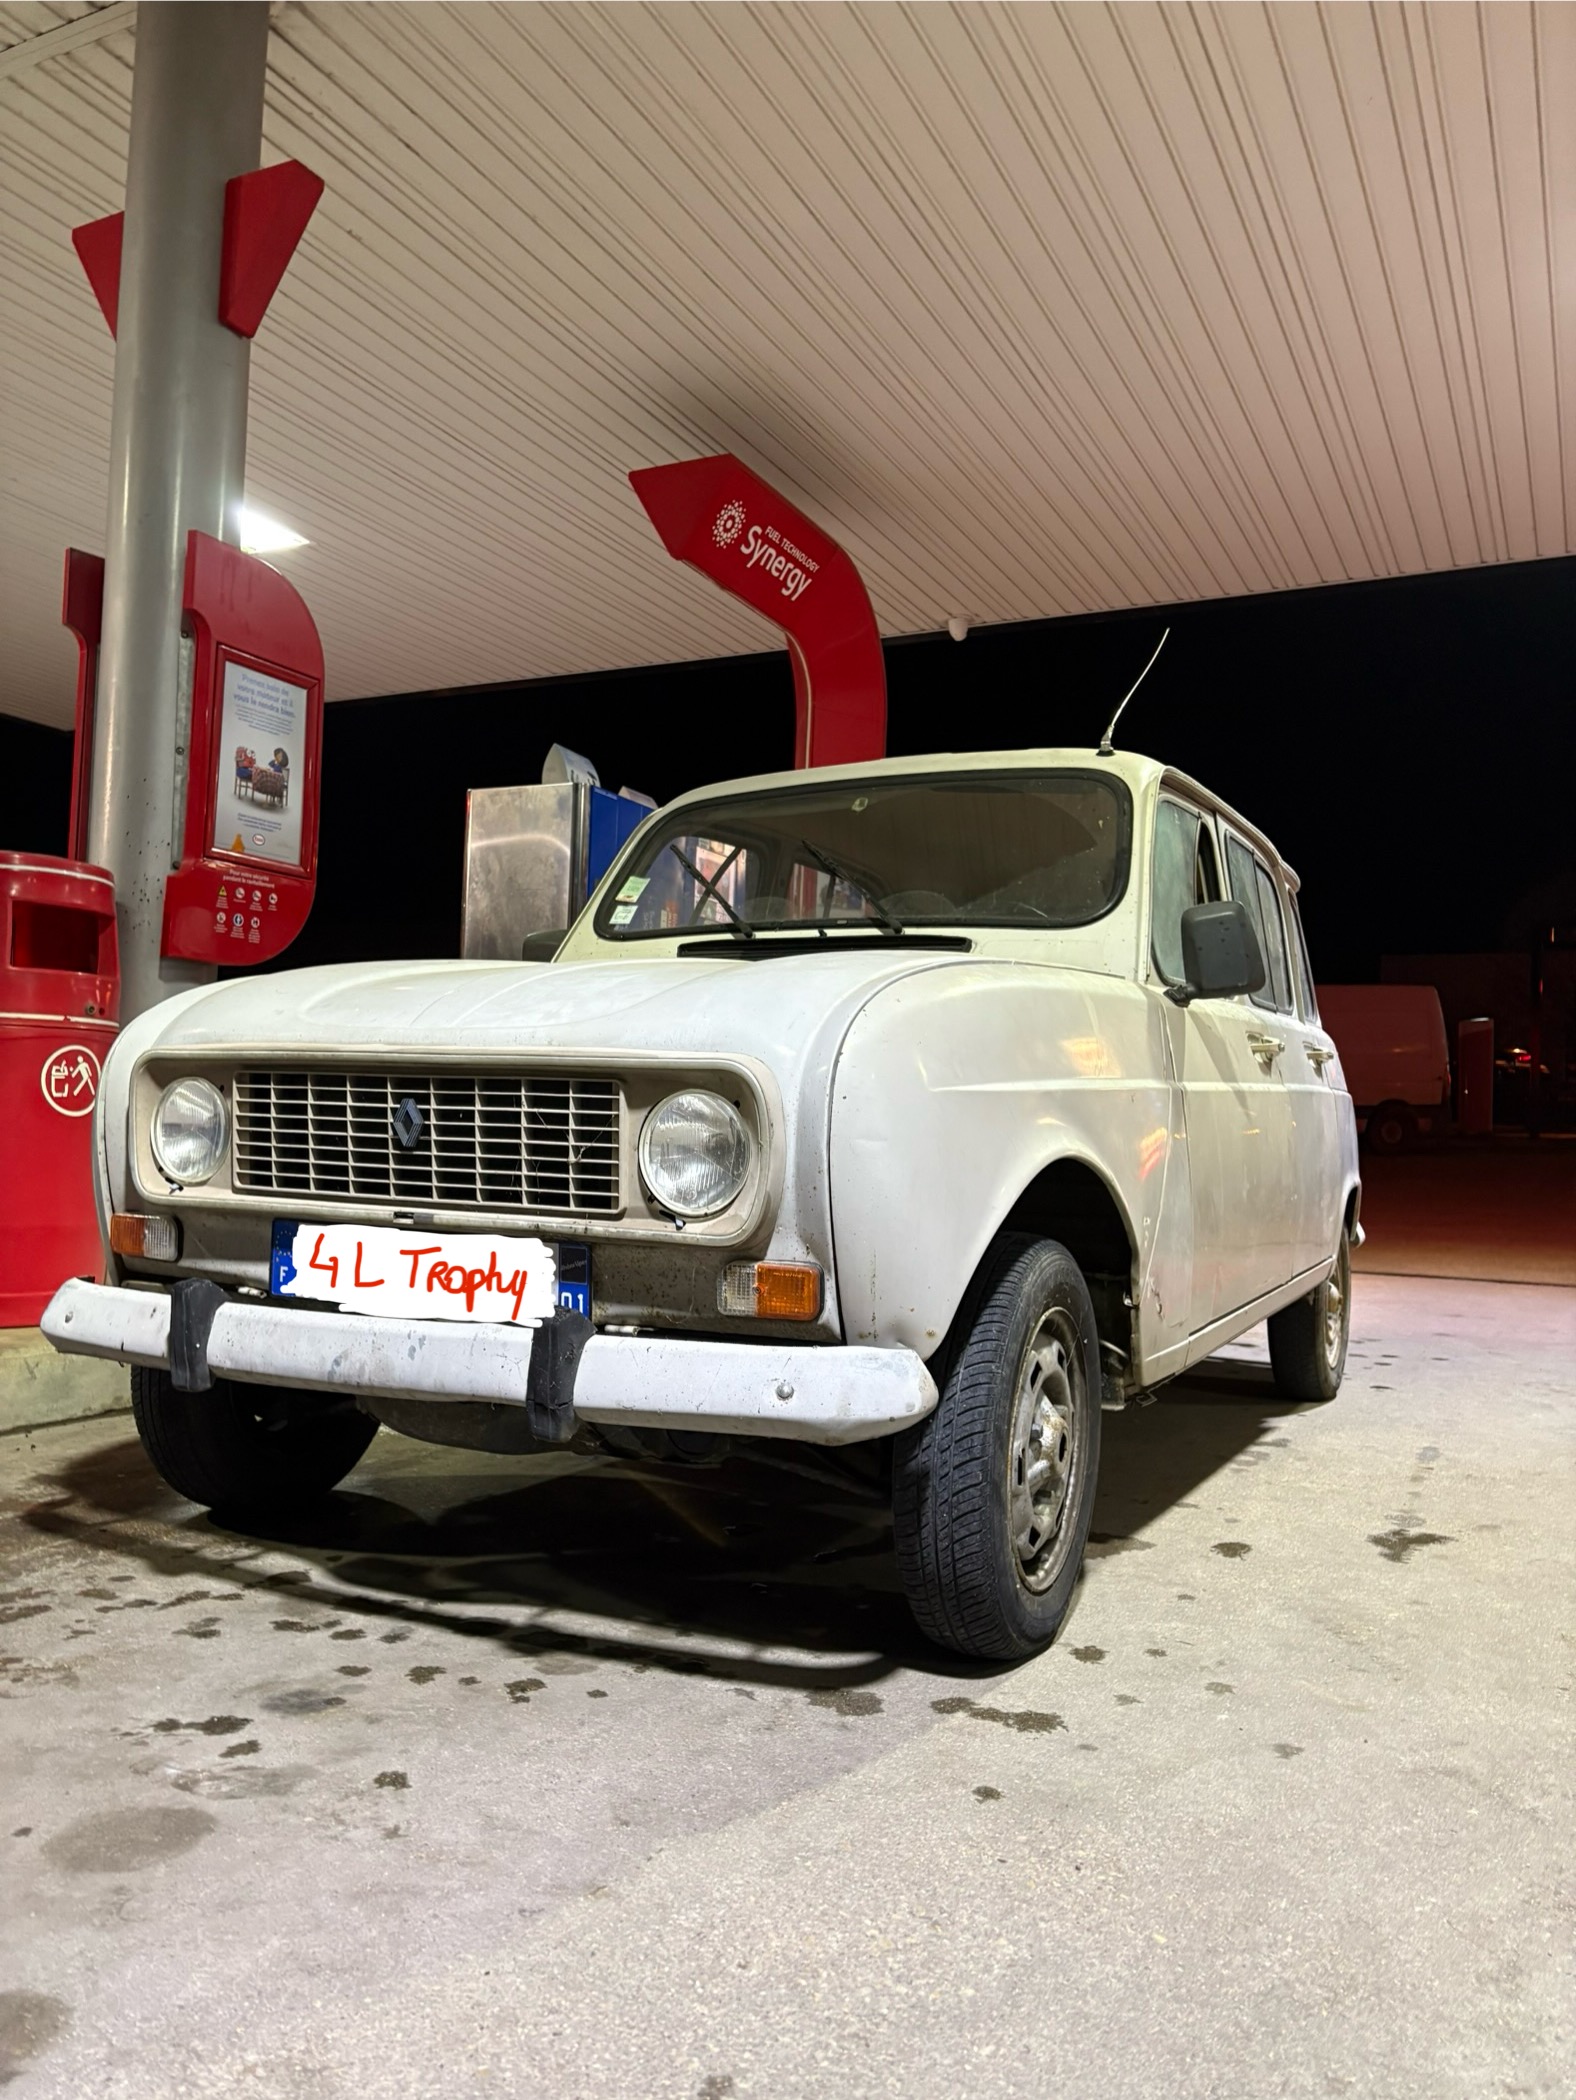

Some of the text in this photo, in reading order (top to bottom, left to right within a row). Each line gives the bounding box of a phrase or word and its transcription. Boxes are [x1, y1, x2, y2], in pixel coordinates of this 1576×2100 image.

[740, 525, 812, 602] Synergy
[765, 525, 820, 573] FUEL TECHNOLOGY
[279, 1266, 288, 1283] F
